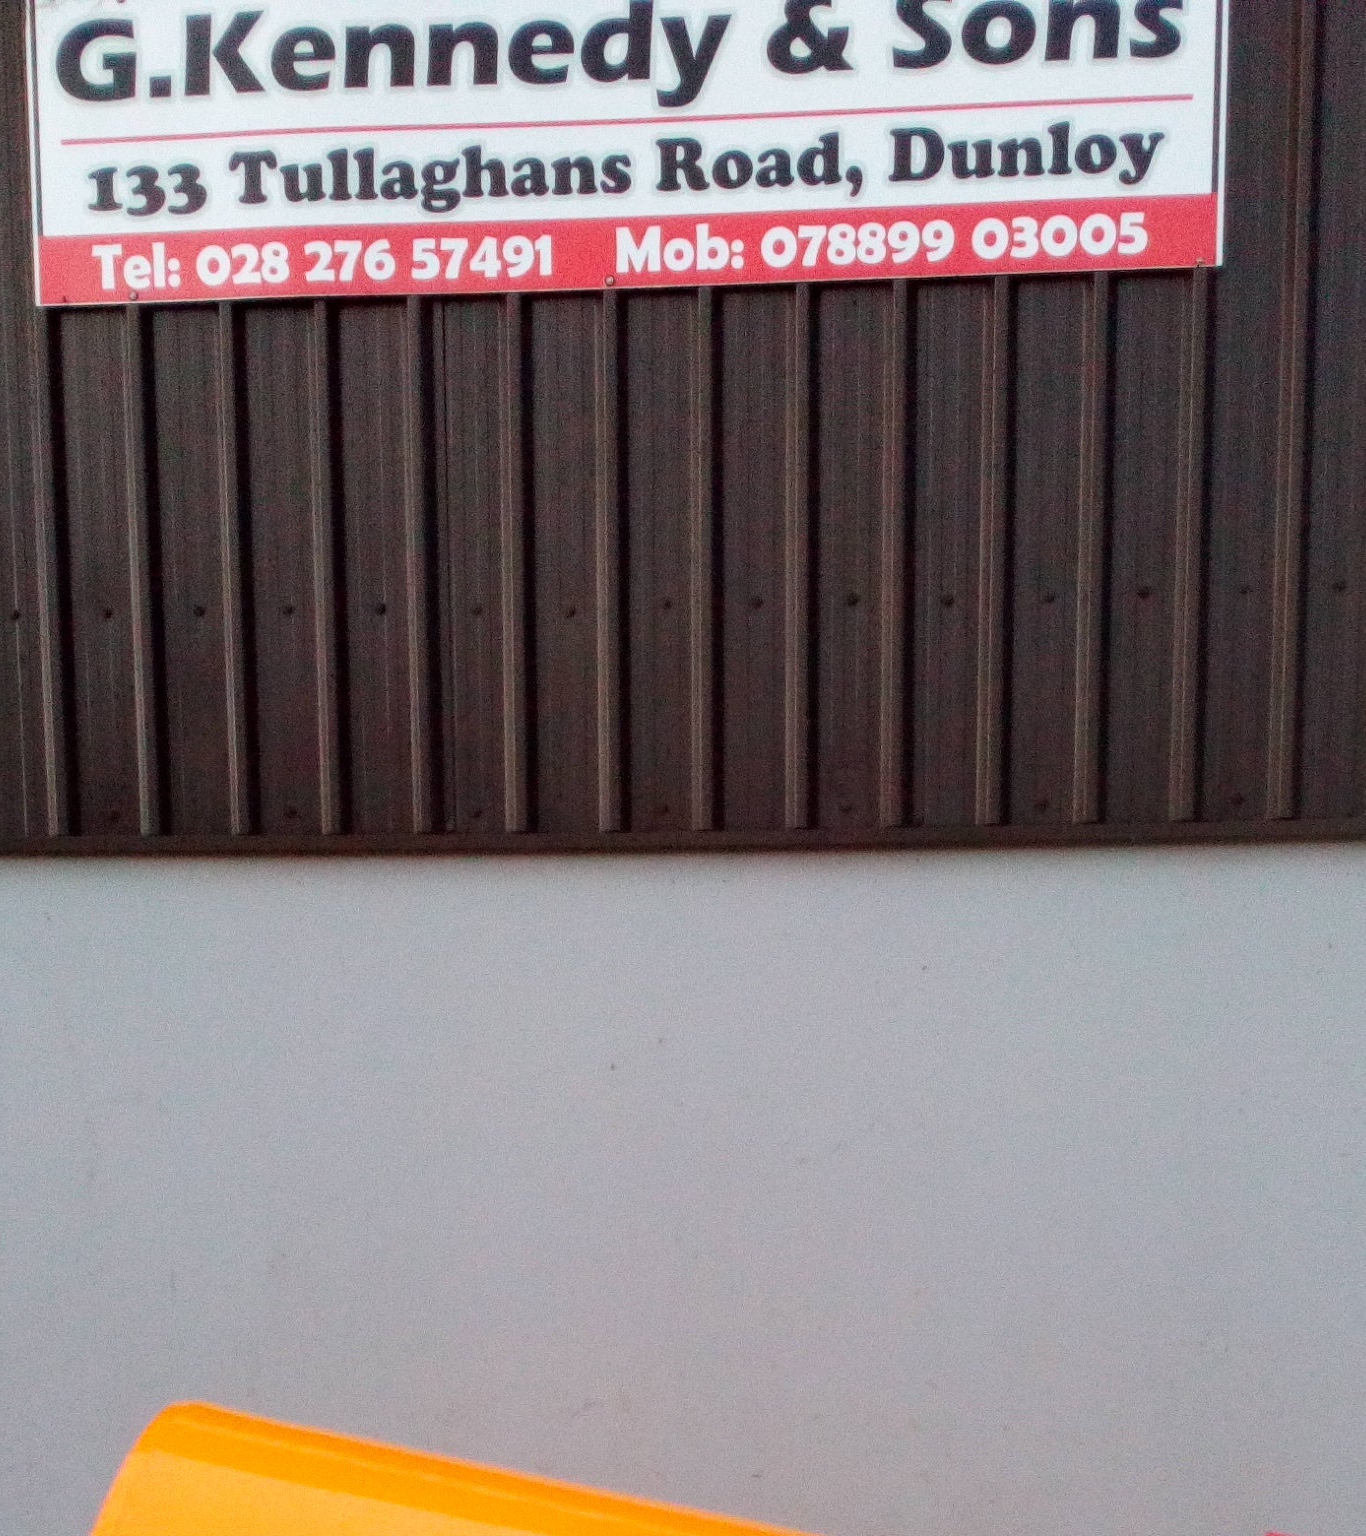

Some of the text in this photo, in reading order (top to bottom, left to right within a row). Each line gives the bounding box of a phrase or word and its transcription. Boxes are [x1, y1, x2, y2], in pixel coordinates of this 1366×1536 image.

[55, 0, 1183, 107] G.Kennedy & Sons
[87, 120, 1165, 216] 133 Tullaghans Road, Dunloy
[91, 211, 1149, 290] Tel: 028 276 57491 Mob: 078899 03005
